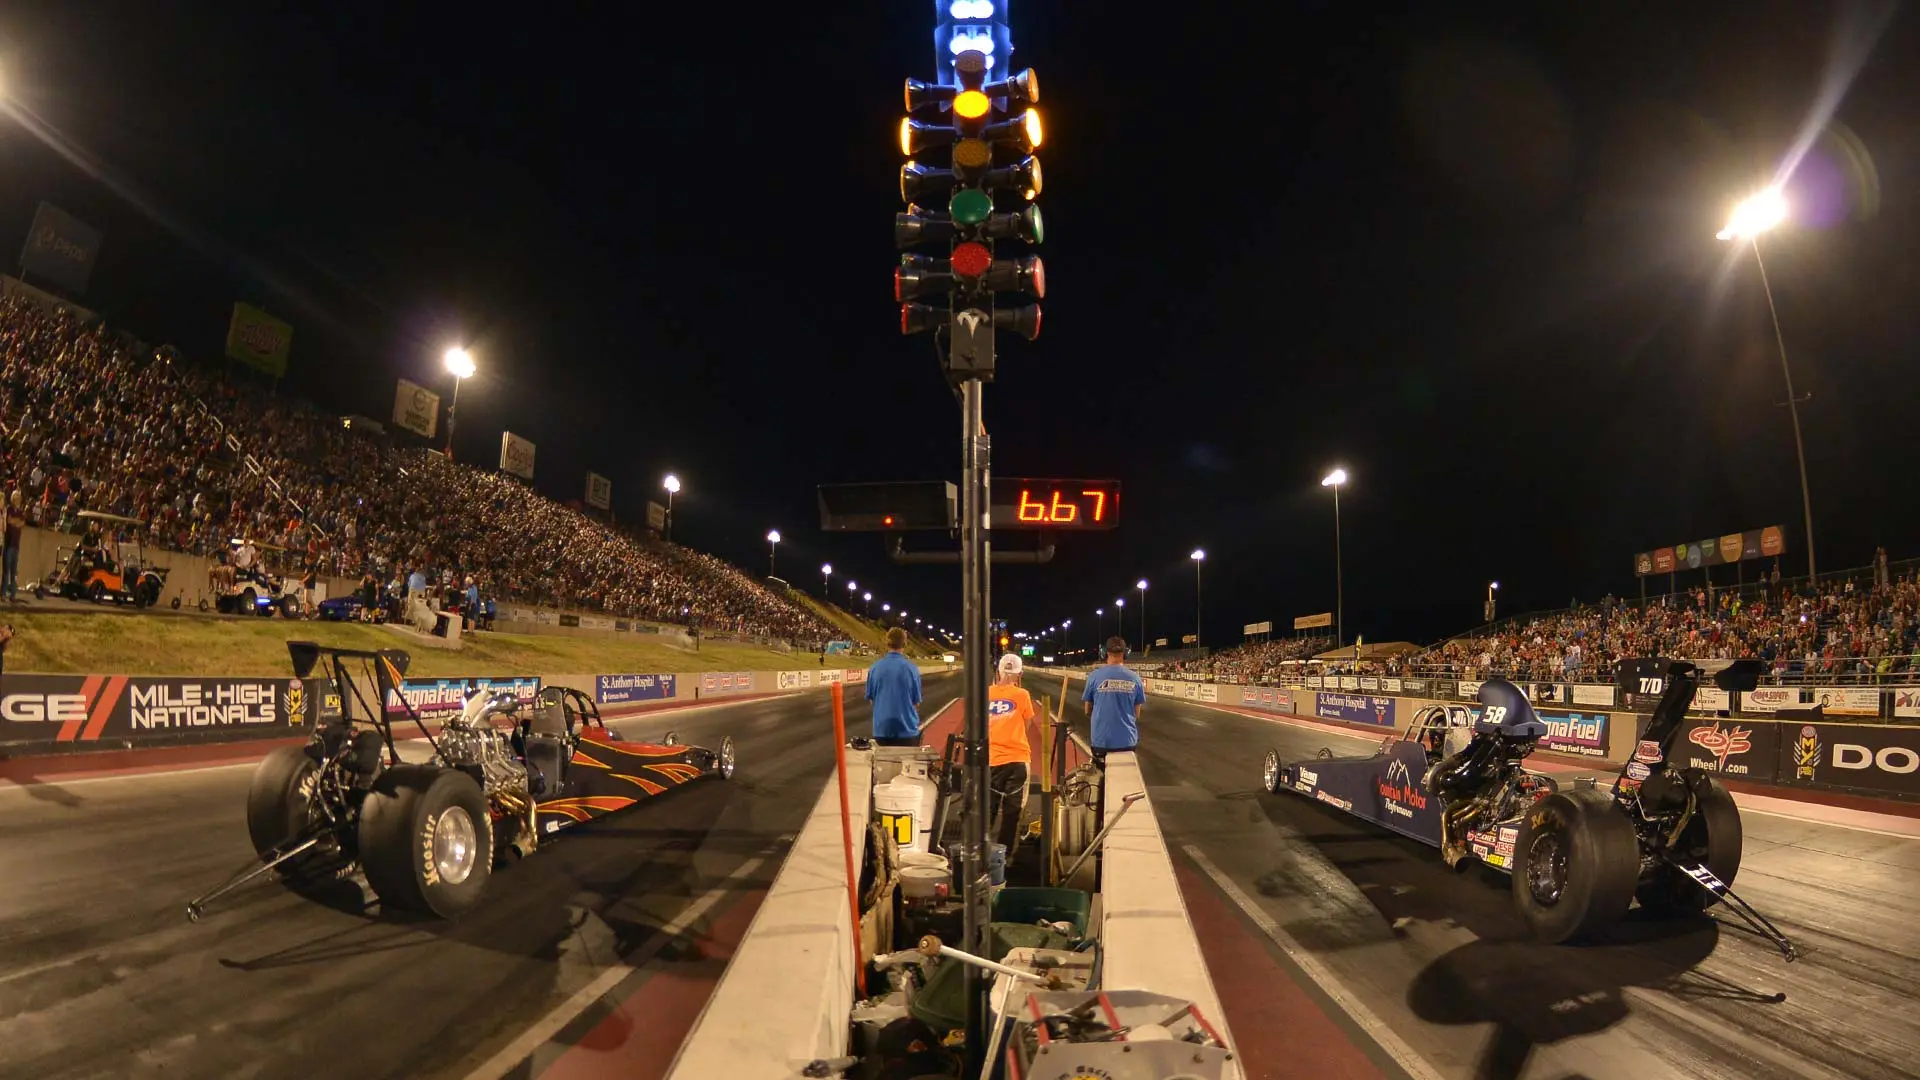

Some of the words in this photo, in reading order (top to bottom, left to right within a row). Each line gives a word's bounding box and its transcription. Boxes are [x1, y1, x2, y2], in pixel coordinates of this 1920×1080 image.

[611, 675, 634, 692] Anthony
[634, 675, 655, 691] Hospital
[1639, 677, 1663, 694] T/D
[1, 694, 87, 722] GE
[1346, 695, 1367, 712] Hospital
[130, 704, 276, 729] NATIONALS
[1482, 705, 1507, 724] 58
[1541, 716, 1601, 741] gnaFuel
[1550, 743, 1567, 752] Racing
[1568, 744, 1580, 752] Fuel
[1580, 745, 1604, 756] Systems
[1832, 743, 1920, 774] DO
[1690, 757, 1717, 771] Wheel
[1404, 785, 1427, 811] Motor
